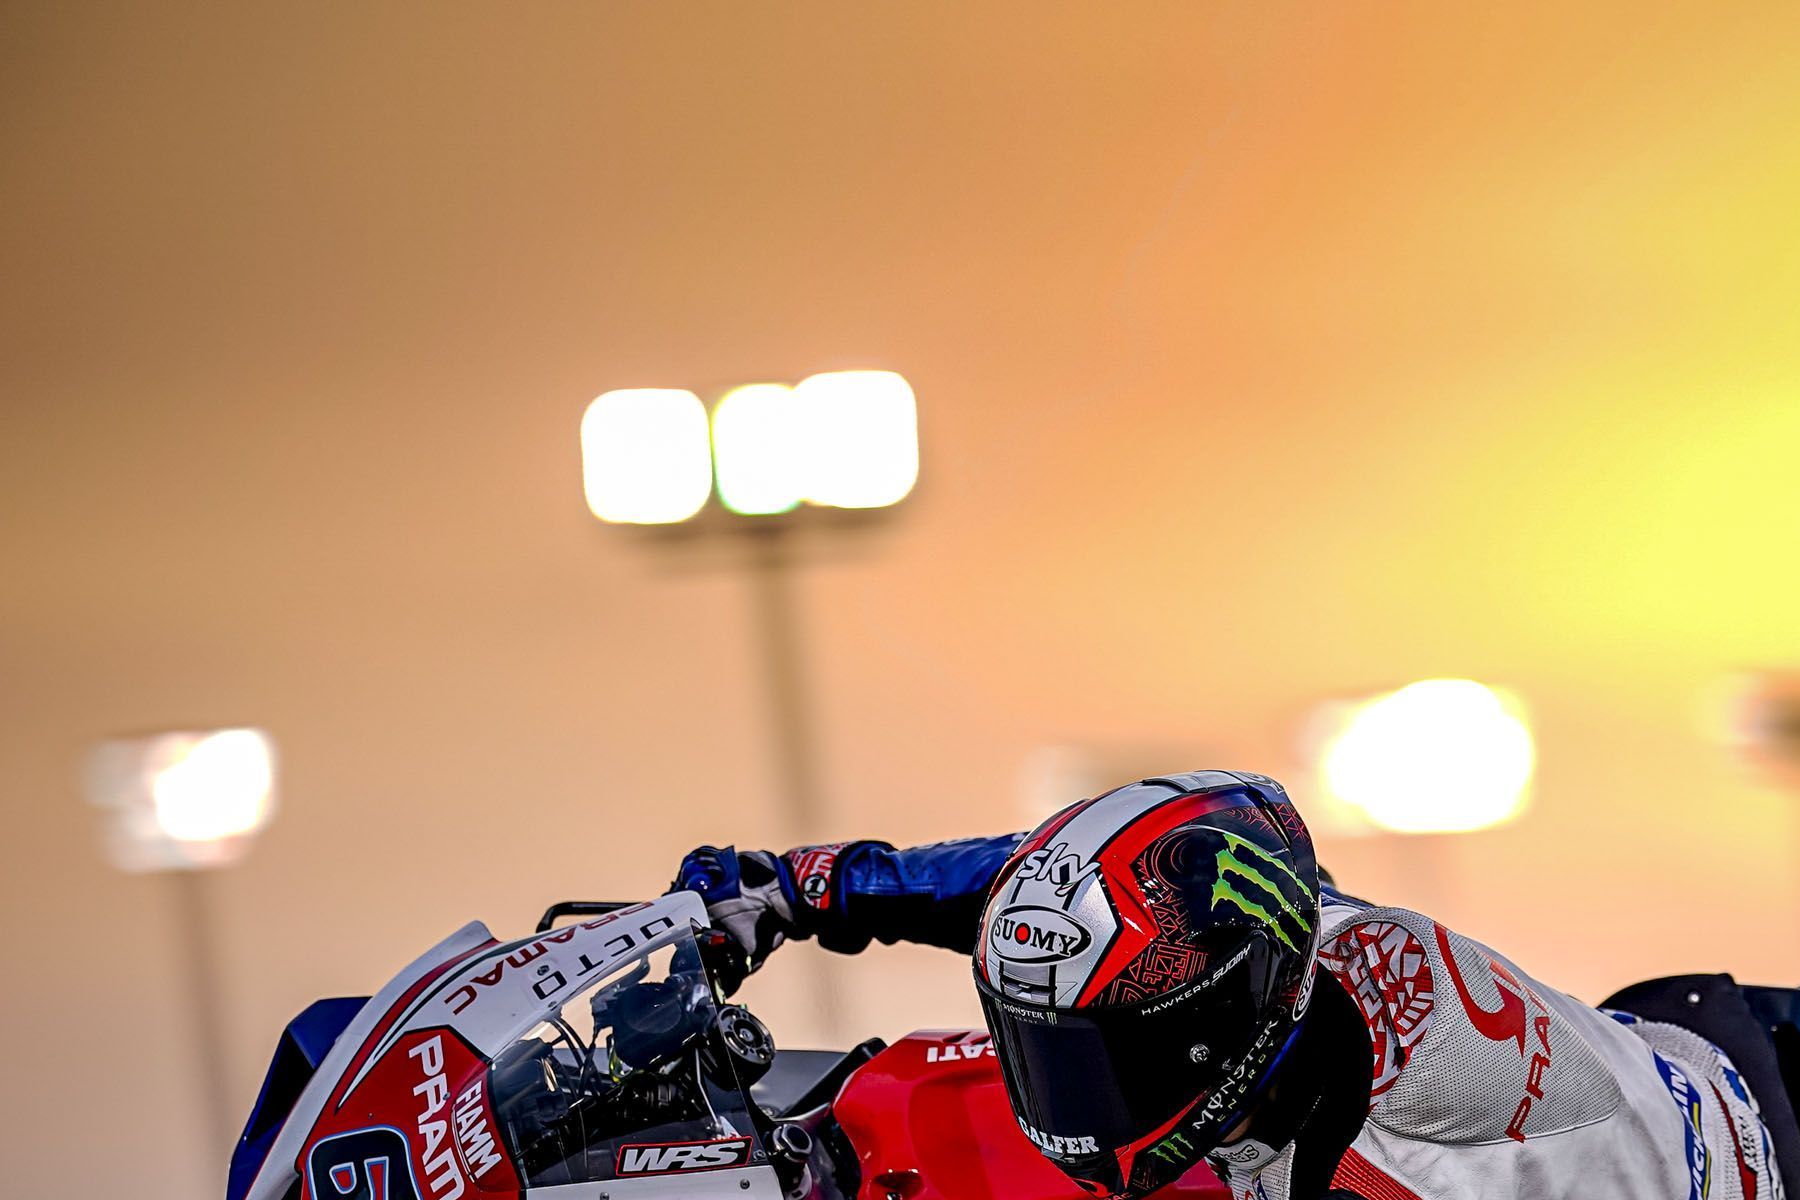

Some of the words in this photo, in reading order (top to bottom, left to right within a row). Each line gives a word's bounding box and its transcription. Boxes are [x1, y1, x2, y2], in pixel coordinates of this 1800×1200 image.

[1017, 843, 1099, 895] sky
[994, 914, 1077, 956] SUOMY
[443, 901, 654, 1015] PRAMAC
[532, 916, 675, 1000] OCTO
[1211, 943, 1251, 982] SUOMY
[1003, 1003, 1044, 1020] MONSTER
[1141, 979, 1210, 1016] HAWKERS
[1192, 1020, 1278, 1130] MONSTER
[456, 1080, 503, 1179] FIAMM
[1019, 1116, 1099, 1154] GALFER
[621, 1140, 747, 1173] WRS
